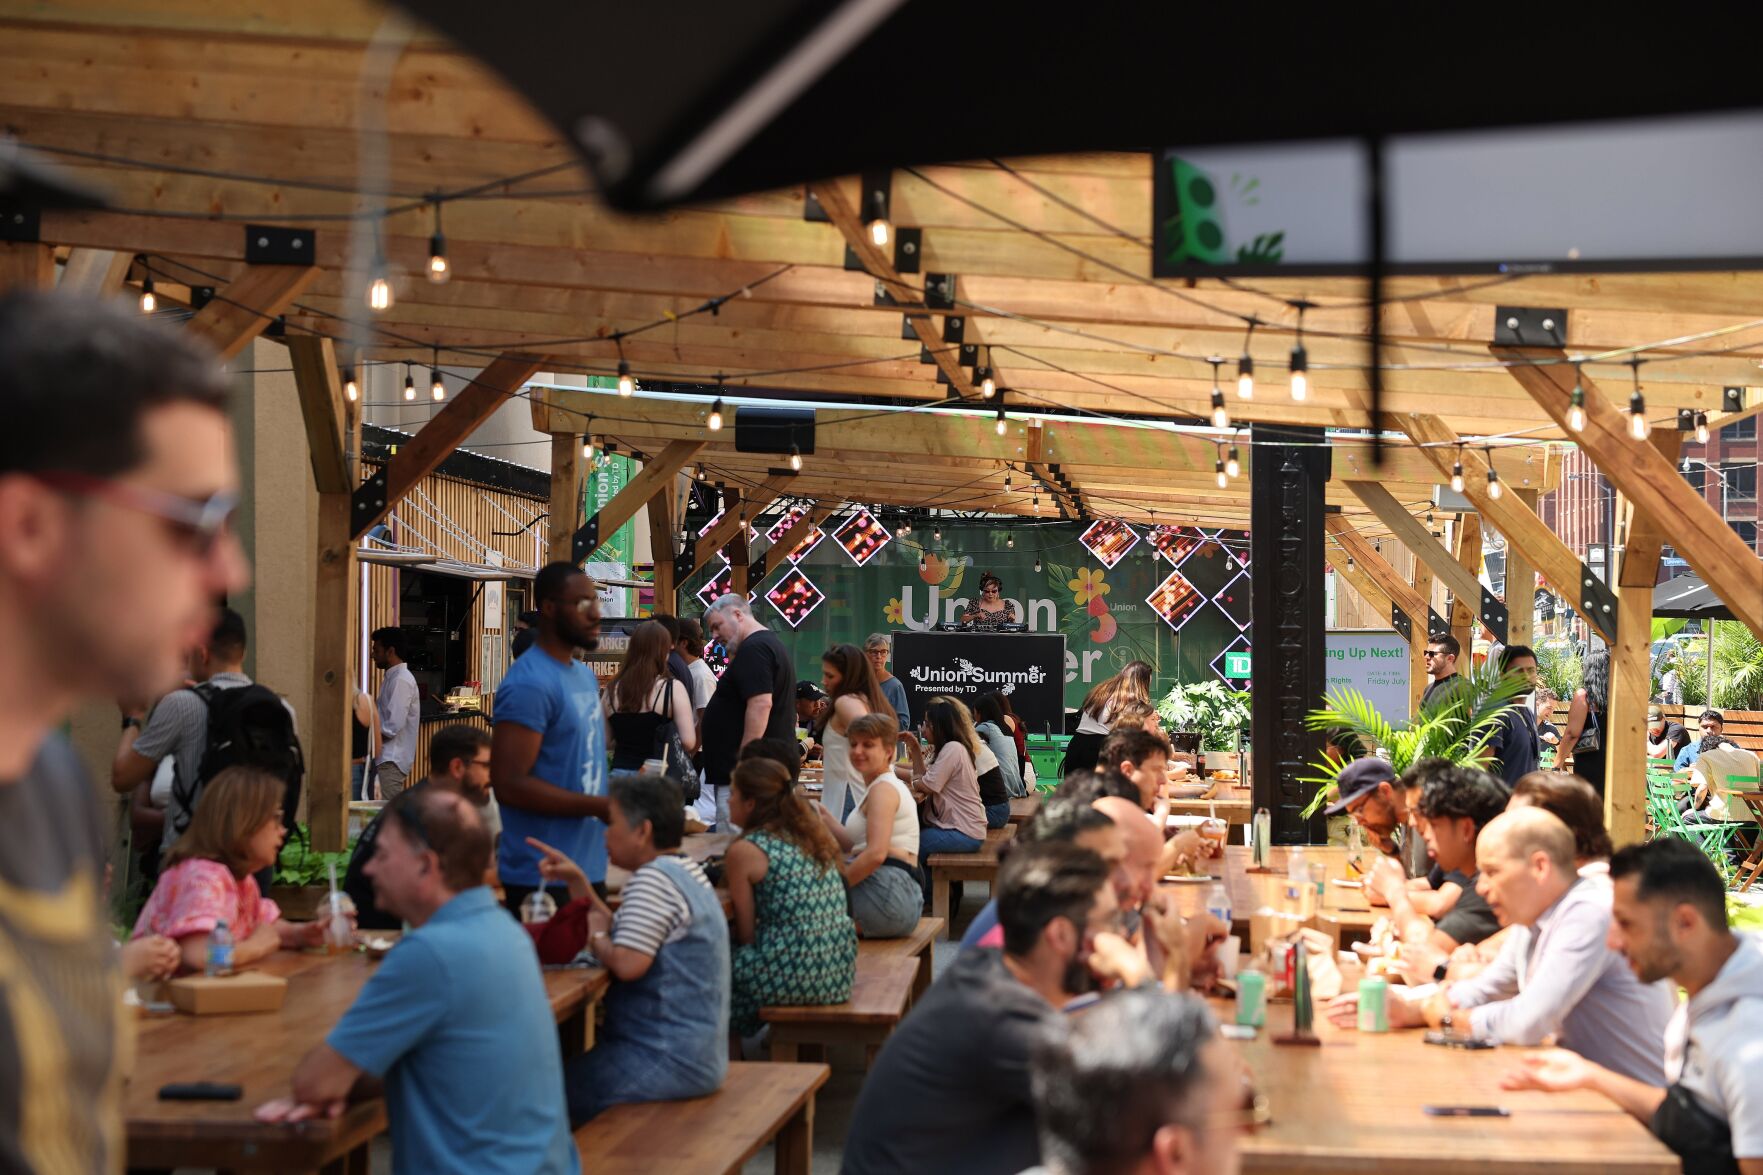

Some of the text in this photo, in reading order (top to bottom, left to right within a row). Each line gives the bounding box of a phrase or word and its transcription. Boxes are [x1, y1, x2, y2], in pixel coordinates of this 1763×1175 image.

[612, 463, 619, 474] TD
[594, 472, 609, 512] nion
[902, 586, 1057, 632] Unn
[1110, 603, 1137, 612] Union
[598, 637, 631, 650] ARKET
[1325, 647, 1403, 660] ing Up Next!
[713, 664, 728, 672] Uni
[1228, 656, 1252, 673] TD
[917, 666, 1046, 684] Union Summer
[1330, 677, 1352, 685] Rights
[1367, 677, 1406, 686] Friday July
[915, 684, 977, 694] Presented by TD
